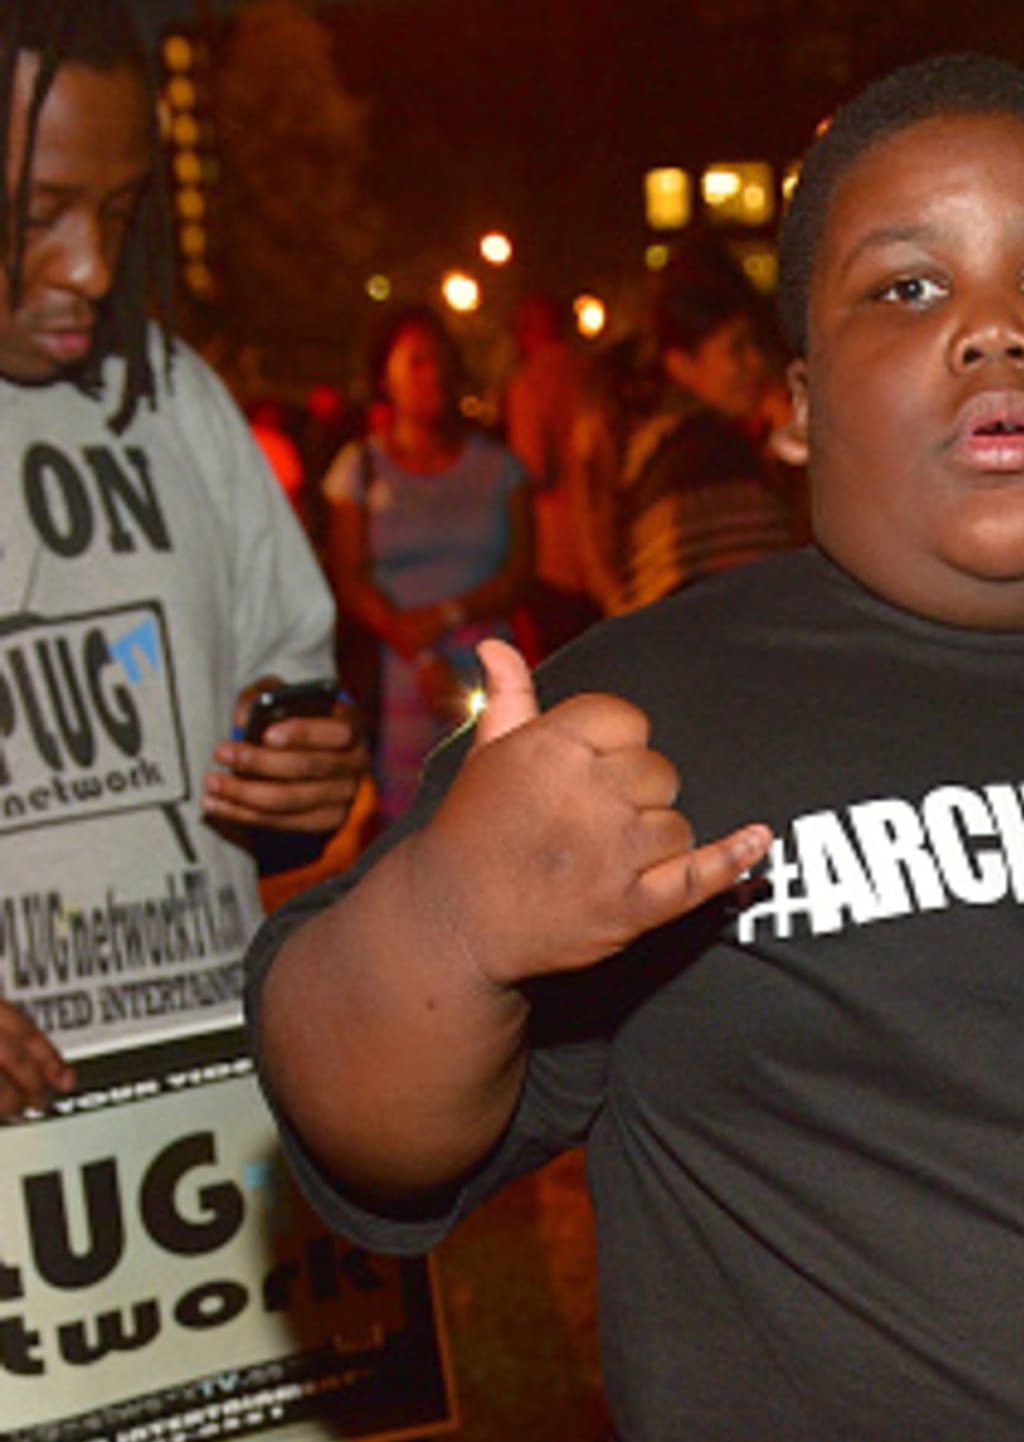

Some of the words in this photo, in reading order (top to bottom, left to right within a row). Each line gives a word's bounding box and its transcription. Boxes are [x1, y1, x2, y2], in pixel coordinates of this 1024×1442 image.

[22, 442, 172, 559] ON
[3, 756, 163, 817] network
[14, 988, 93, 1034] TED
[0, 1131, 245, 1300] UG
